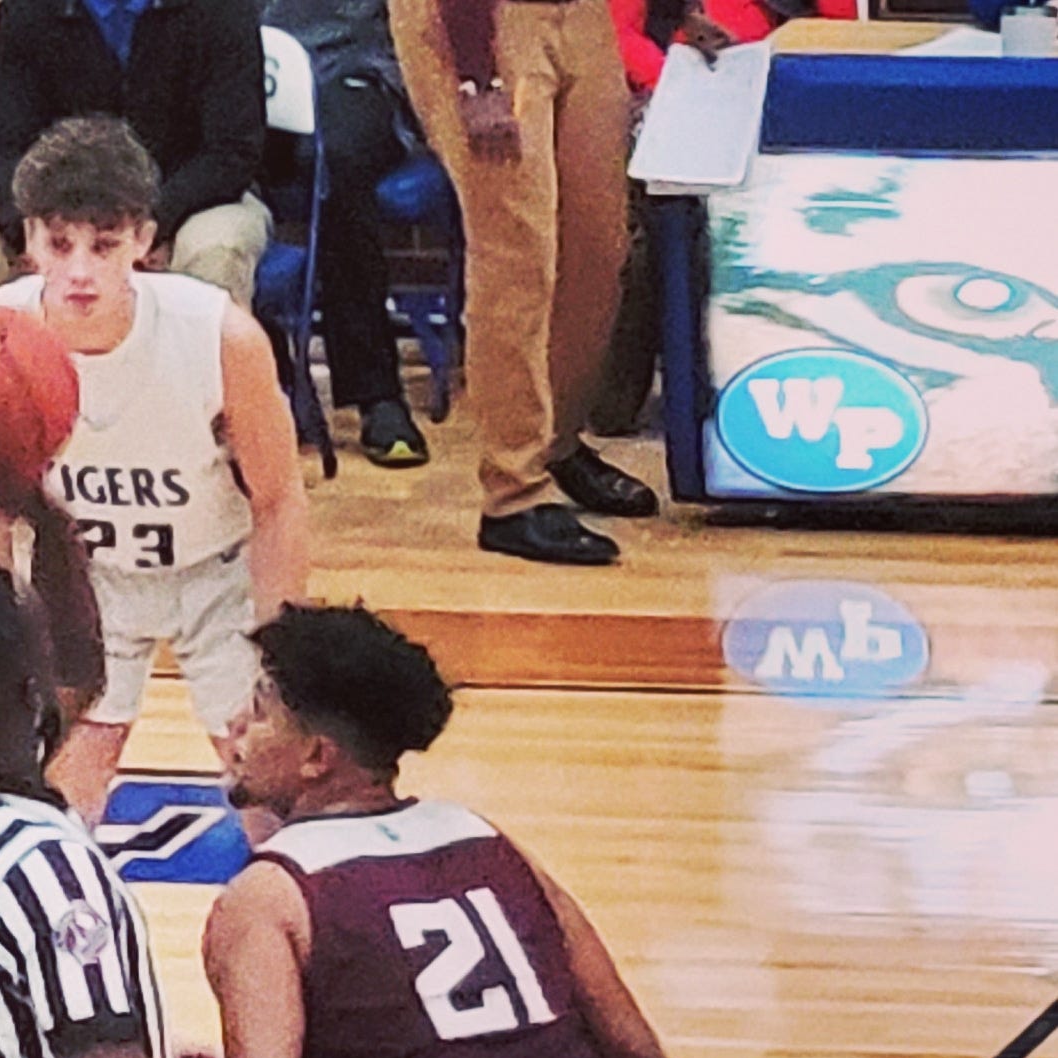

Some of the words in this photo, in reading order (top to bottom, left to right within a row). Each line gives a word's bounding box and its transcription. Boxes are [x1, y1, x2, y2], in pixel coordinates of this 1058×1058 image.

[748, 377, 904, 469] WP
[46, 461, 190, 507] IGERS
[389, 887, 557, 1040] 21
